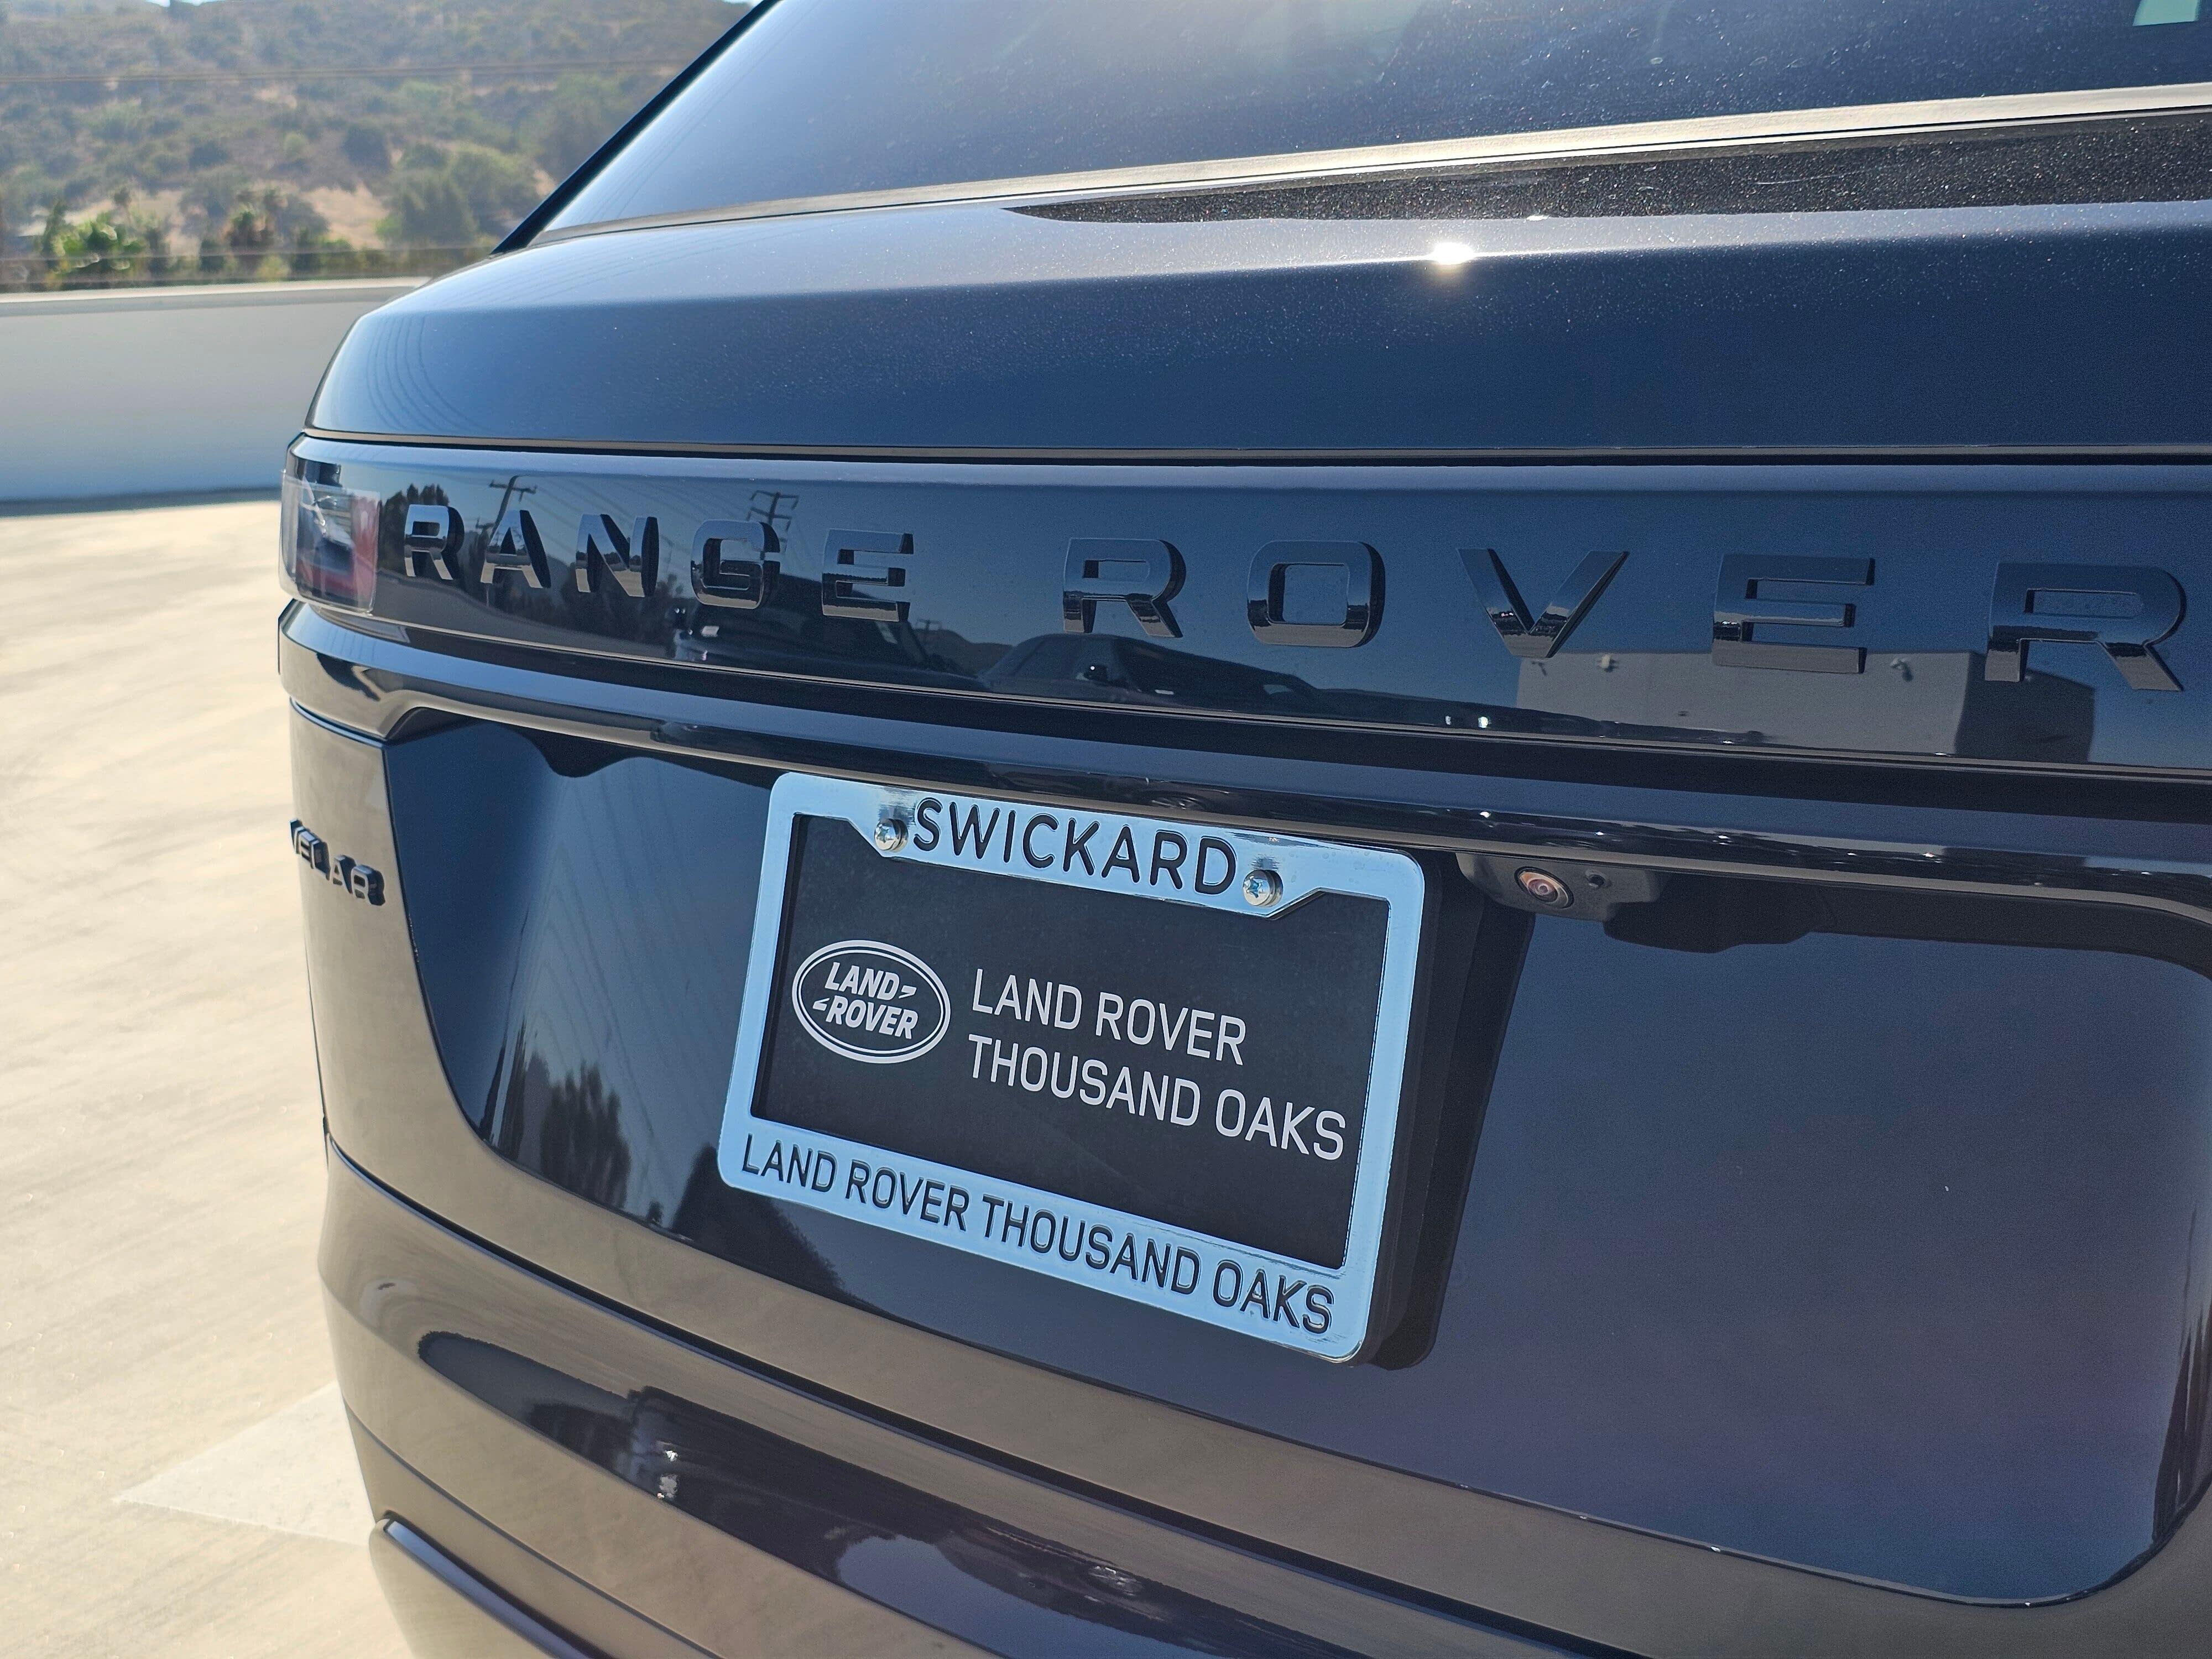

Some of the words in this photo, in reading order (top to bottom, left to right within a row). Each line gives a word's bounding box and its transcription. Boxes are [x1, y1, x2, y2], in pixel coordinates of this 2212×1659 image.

[404, 504, 914, 622] RANGE
[1062, 538, 2187, 692] ROVER
[913, 796, 1238, 895] SWICKARD
[824, 962, 901, 1000] LAND
[825, 995, 919, 1039] ROVER
[972, 968, 1082, 1030] LAND
[1095, 992, 1246, 1066] ROVER
[968, 1034, 1201, 1127] THOUSAND
[1215, 1089, 1346, 1161] OAKS
[742, 1133, 837, 1192] LAND
[845, 1159, 970, 1232] ROVER
[982, 1193, 1202, 1295] THOUSAND
[1213, 1258, 1334, 1334] OAKS
